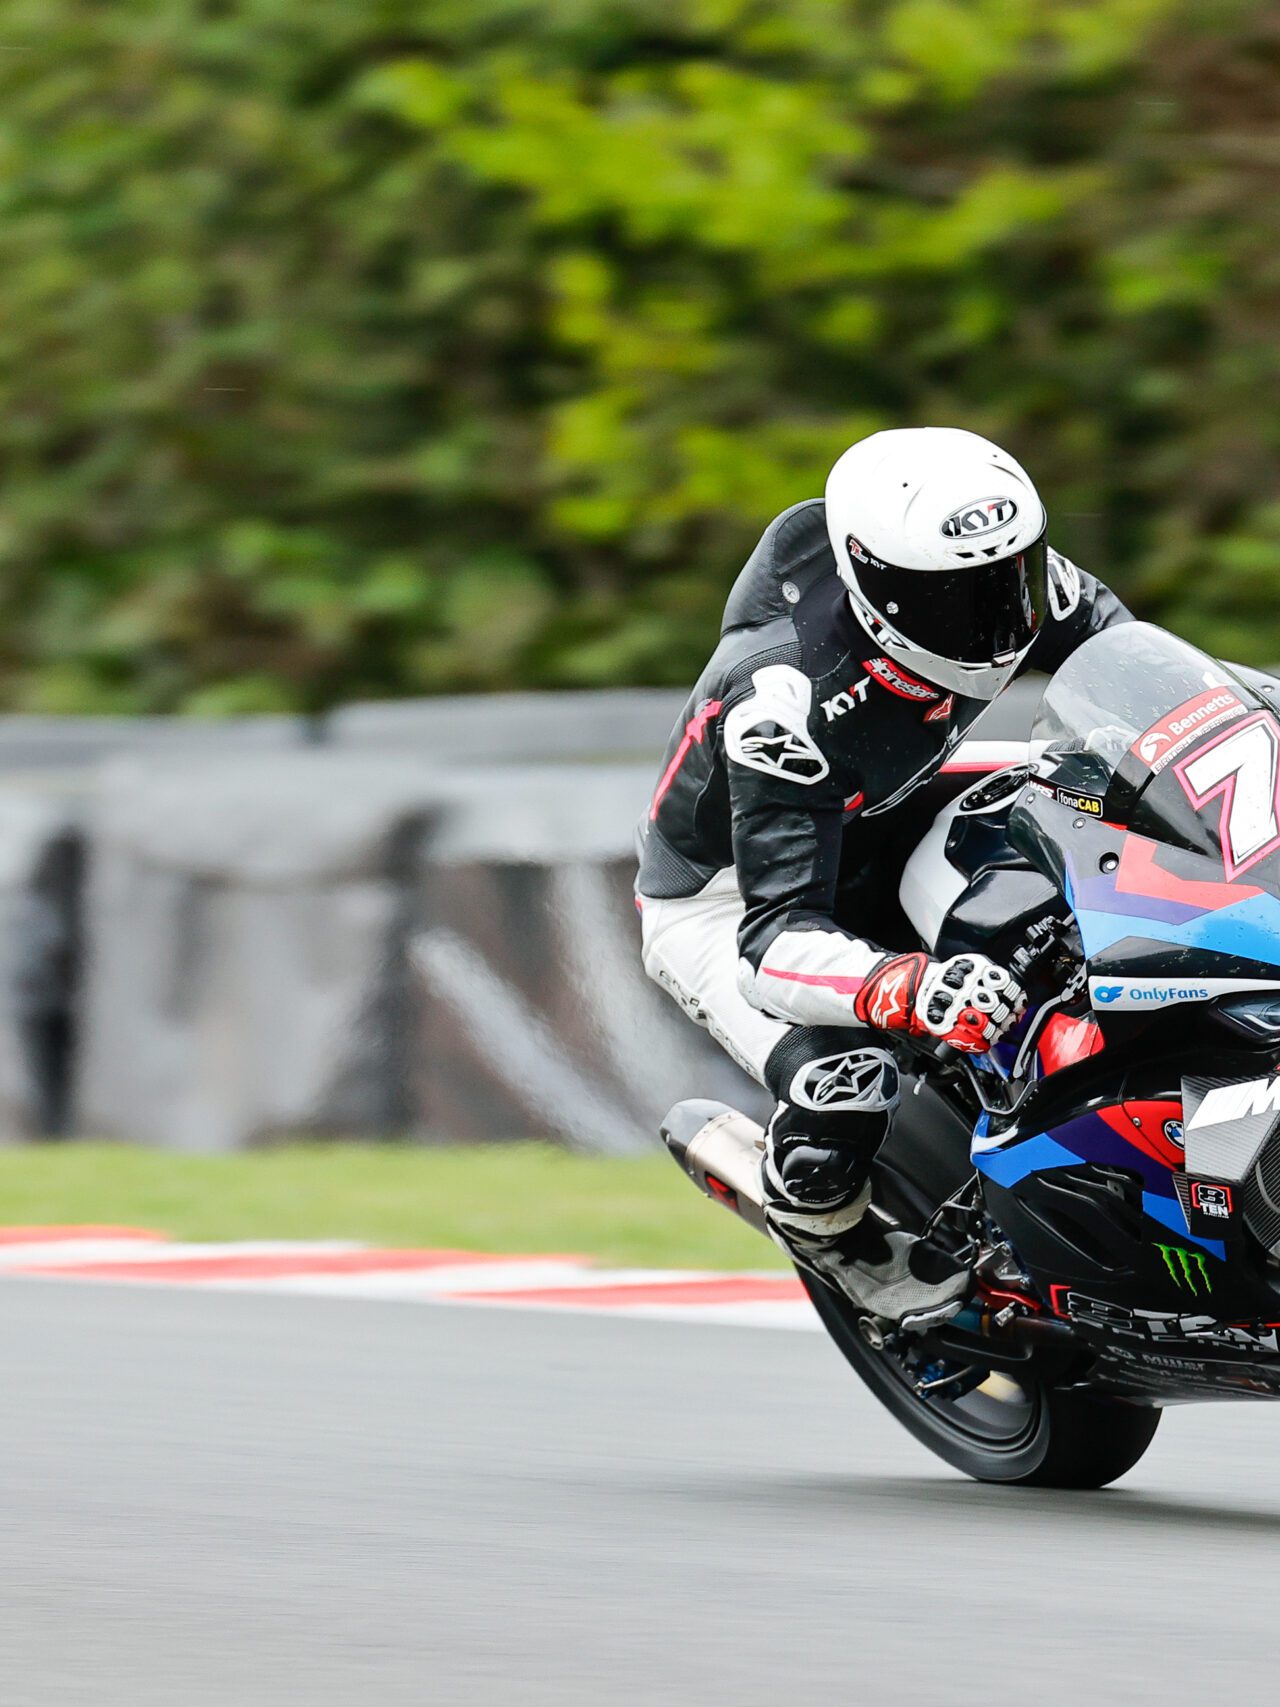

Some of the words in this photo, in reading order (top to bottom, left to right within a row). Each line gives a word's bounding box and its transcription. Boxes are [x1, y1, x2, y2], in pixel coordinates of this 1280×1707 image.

[951, 499, 1008, 537] KYT
[870, 557, 887, 570] KYT
[820, 675, 871, 722] KYT
[1168, 693, 1235, 736] Bennetts
[1060, 792, 1100, 813] fonaCAB
[1129, 988, 1208, 1002] OnlyFans
[1200, 1203, 1228, 1216] TEN
